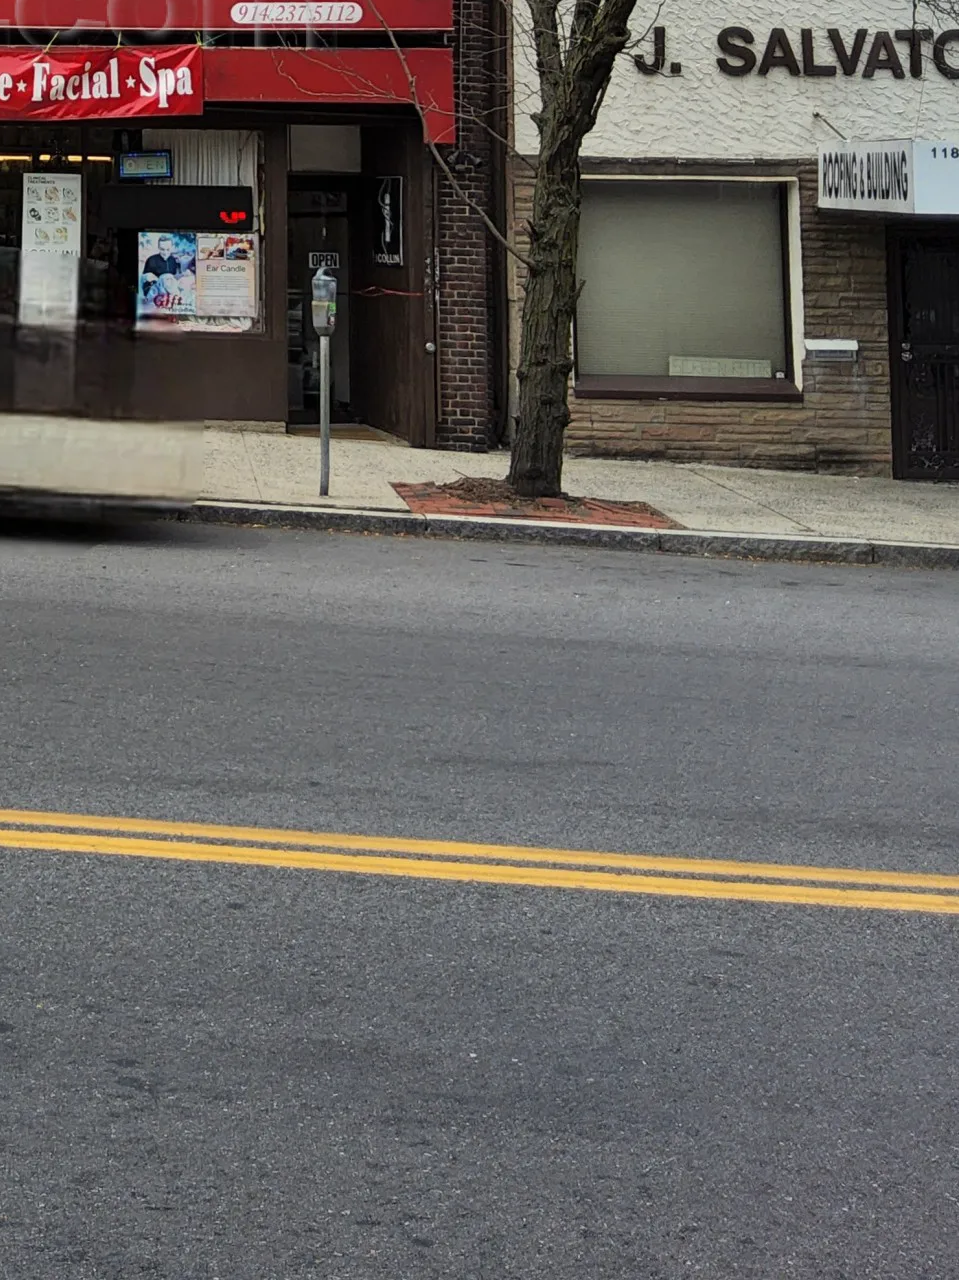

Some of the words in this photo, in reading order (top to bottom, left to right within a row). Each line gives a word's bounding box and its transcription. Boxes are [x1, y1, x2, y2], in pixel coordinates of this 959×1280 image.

[238, 4, 356, 22] 914.237.5112
[634, 26, 681, 76] J.
[31, 58, 122, 103] Facial
[139, 57, 193, 108] Spa
[822, 152, 858, 200] ROOFING
[859, 157, 865, 200] &
[867, 150, 908, 201] BUILDING
[206, 264, 219, 272] Ear
[221, 264, 246, 272] Candle
[311, 253, 337, 267] OPEN
